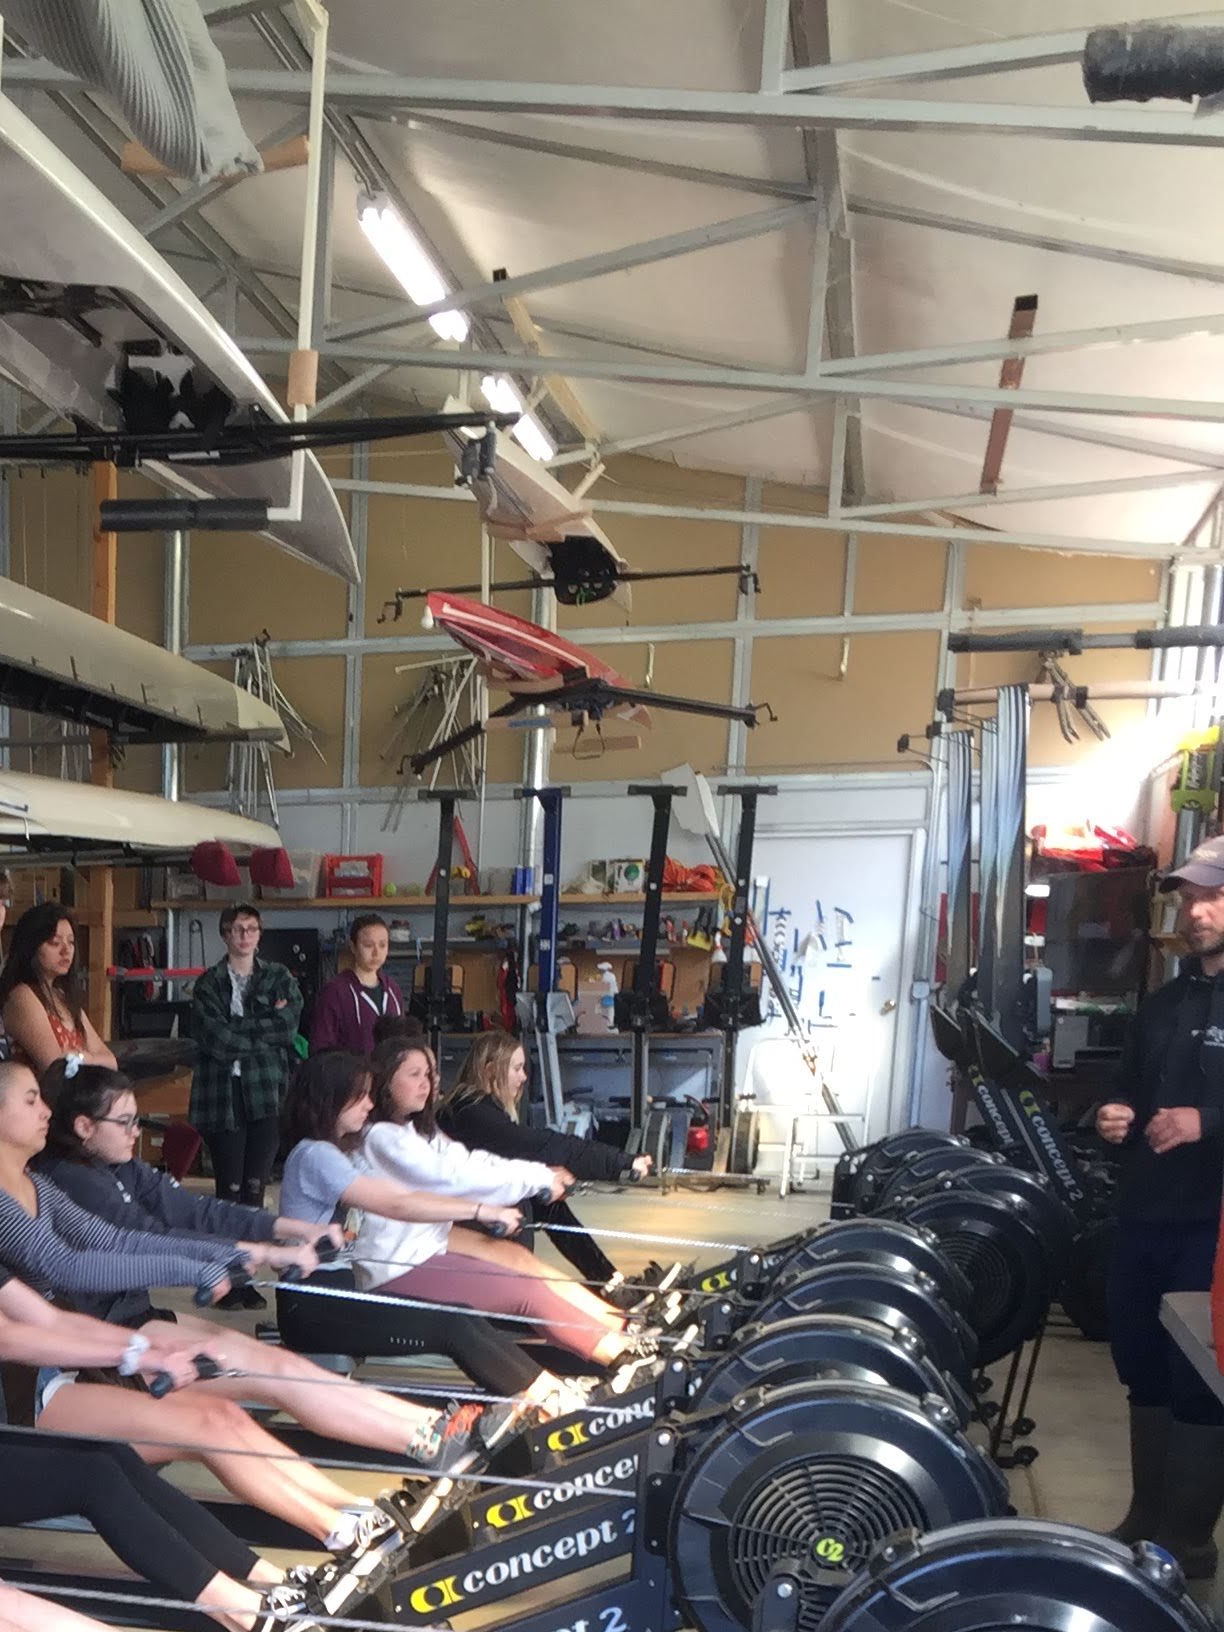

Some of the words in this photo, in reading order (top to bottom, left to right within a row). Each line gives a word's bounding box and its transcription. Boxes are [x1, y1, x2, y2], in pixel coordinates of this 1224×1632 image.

[1032, 1115, 1076, 1188] concept
[1069, 1188, 1084, 1201] 2
[533, 1454, 639, 1510] conce
[463, 1520, 618, 1593] concept
